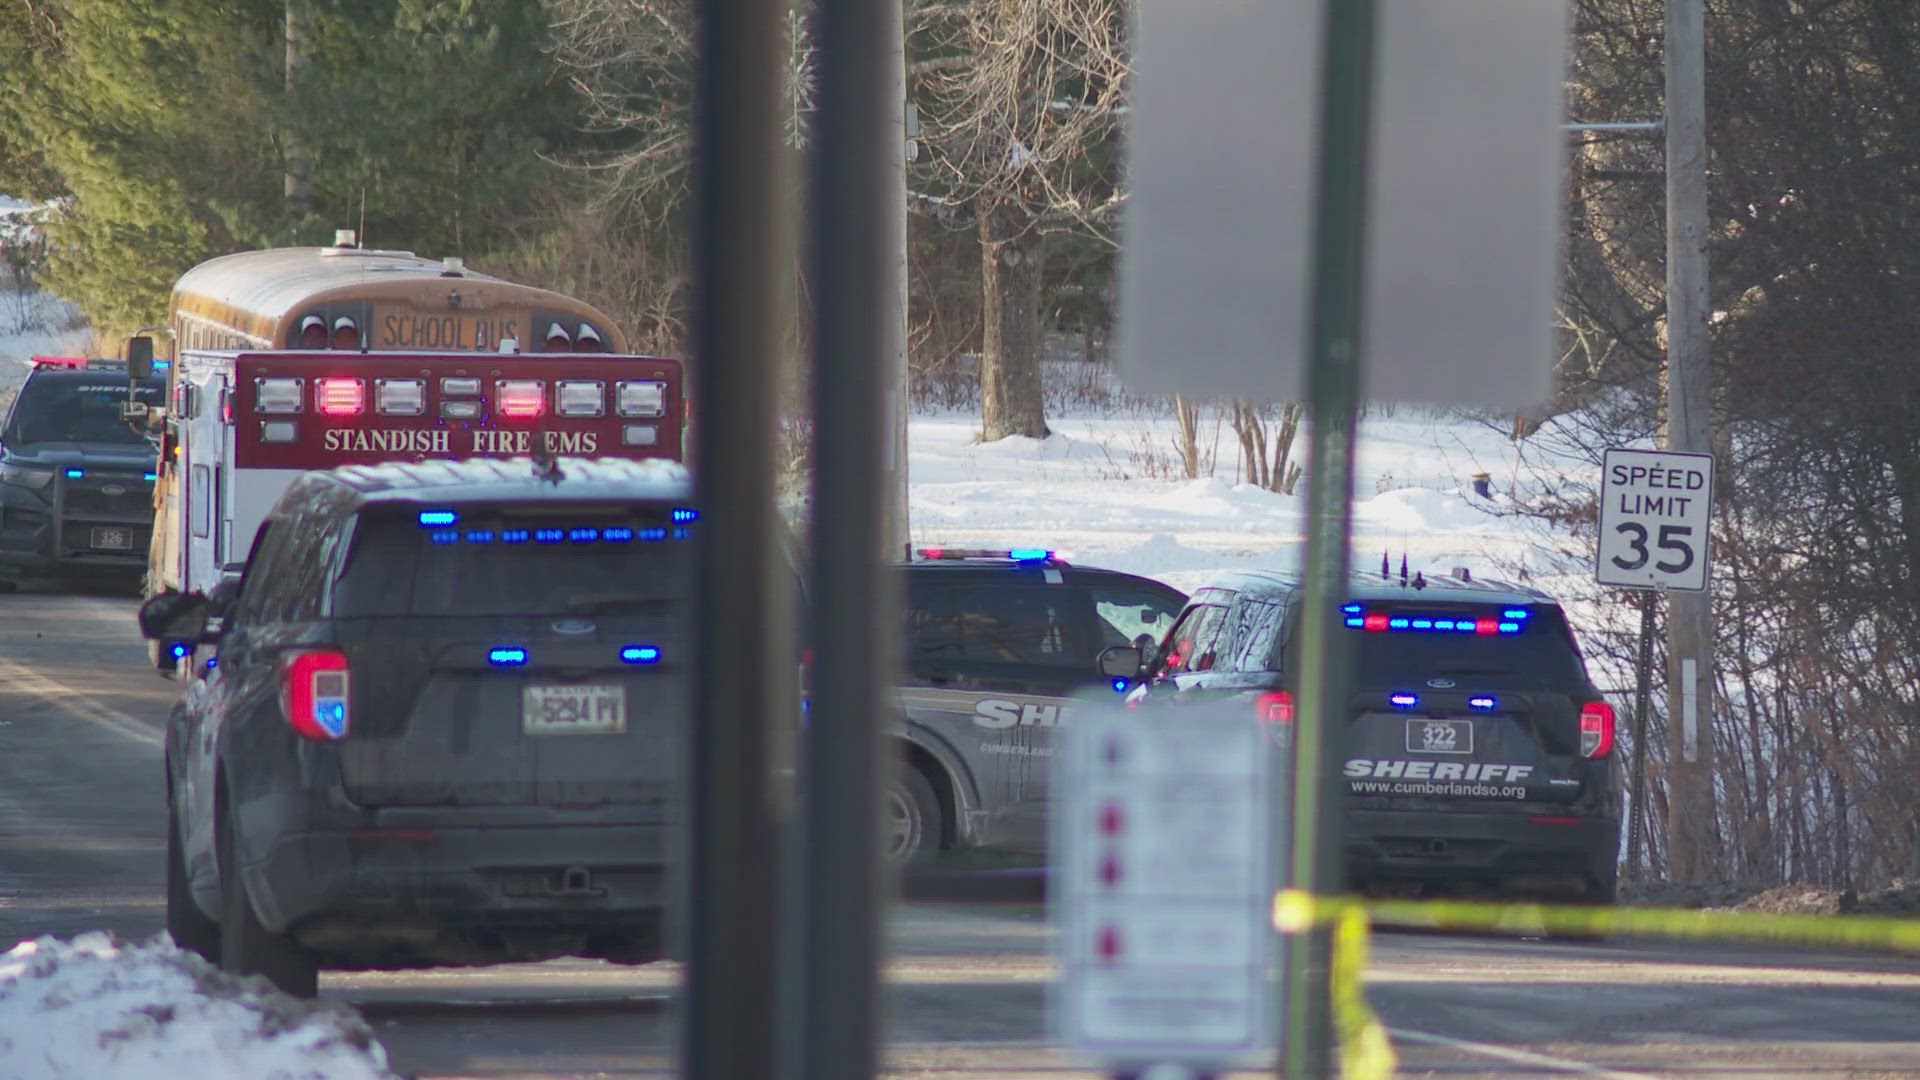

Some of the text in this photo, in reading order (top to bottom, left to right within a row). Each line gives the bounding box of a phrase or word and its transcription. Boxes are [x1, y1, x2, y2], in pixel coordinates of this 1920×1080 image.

[384, 315, 518, 350] SCHOOL BUS
[324, 428, 598, 454] STANDISH FIRE EMS
[1611, 465, 1704, 490] SPEED
[1620, 493, 1692, 517] LIMIT
[1611, 522, 1694, 574] 35
[543, 696, 590, 723] 5294
[1422, 727, 1456, 745] 322
[980, 743, 1054, 757] CUMBERLAND
[1343, 758, 1534, 782] SHERIFF
[1351, 779, 1526, 799] www.cumberlandso.org
